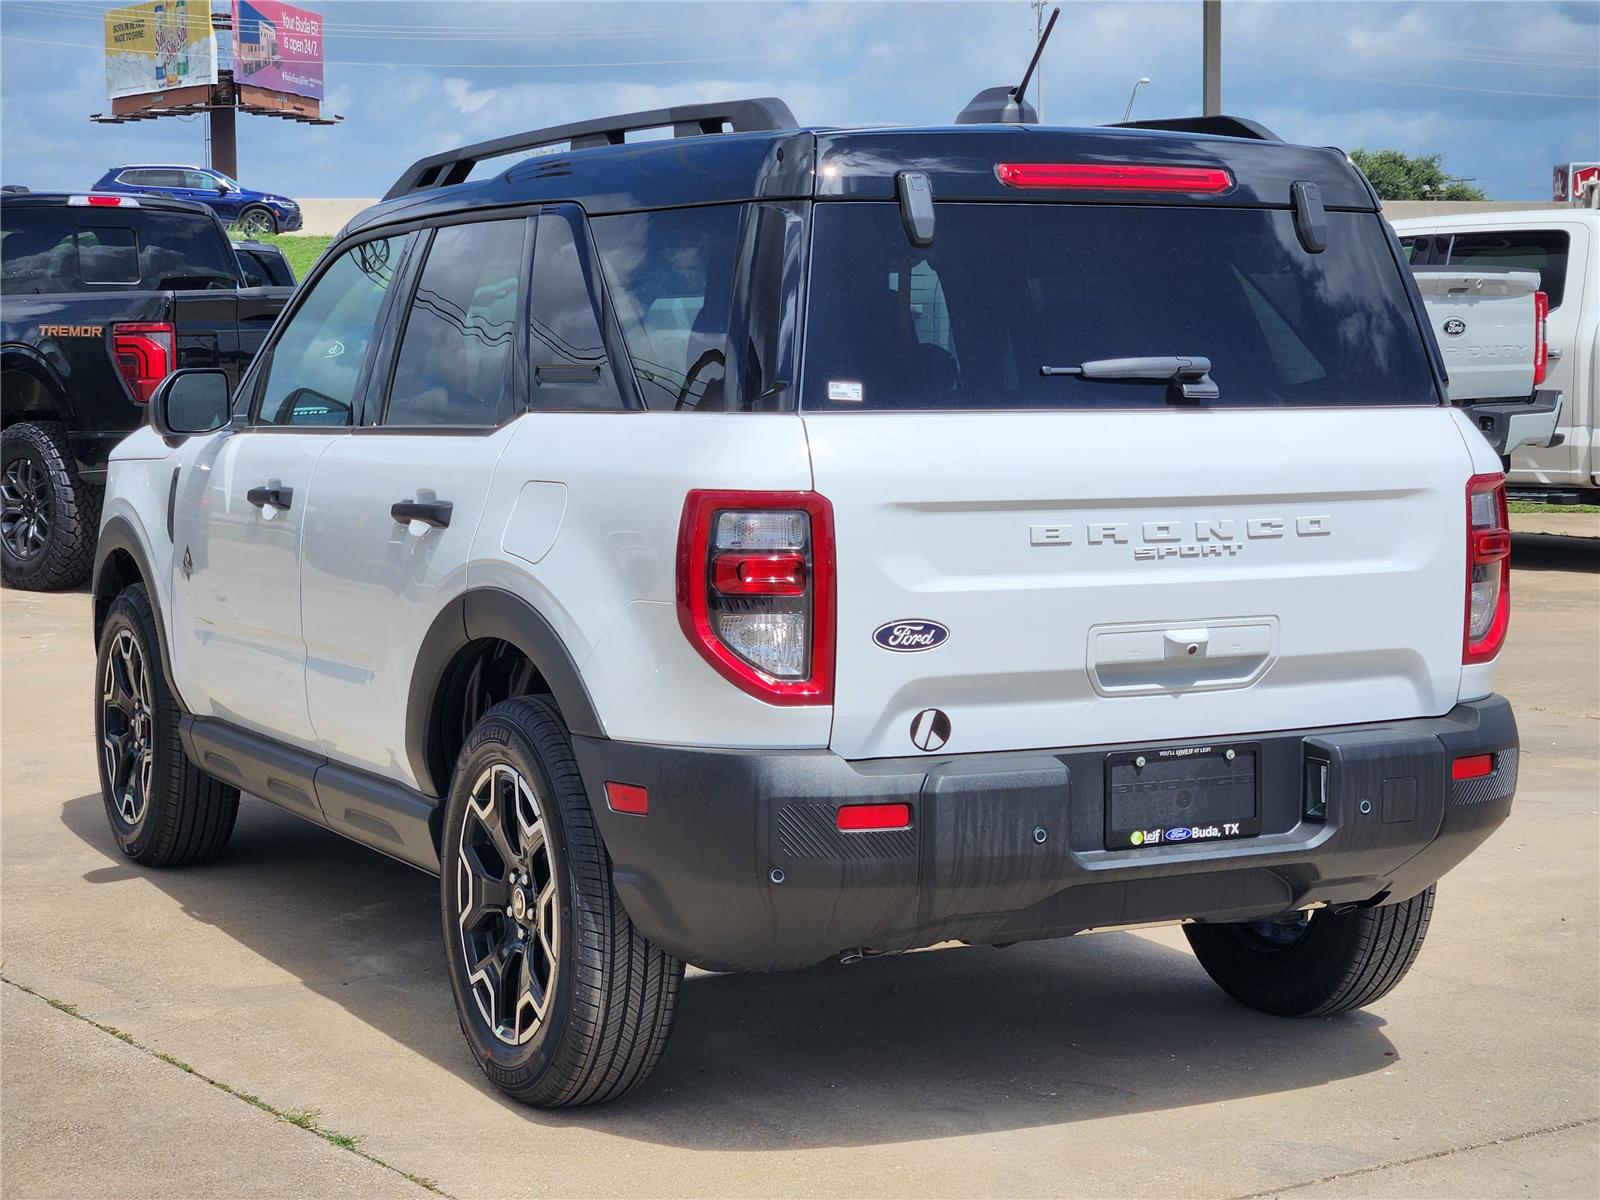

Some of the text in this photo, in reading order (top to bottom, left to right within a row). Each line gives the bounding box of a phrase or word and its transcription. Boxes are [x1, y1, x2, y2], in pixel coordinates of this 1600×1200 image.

[281, 11, 295, 30] Your
[295, 16, 311, 34] Buda
[283, 32, 289, 49] is
[289, 37, 304, 55] open
[38, 324, 104, 338] TREMOR
[1030, 515, 1331, 547] BRONCO
[1134, 542, 1243, 561] SPORT
[888, 625, 936, 646] Ford
[1191, 825, 1221, 839] Buda,
[1223, 823, 1240, 835] TX
